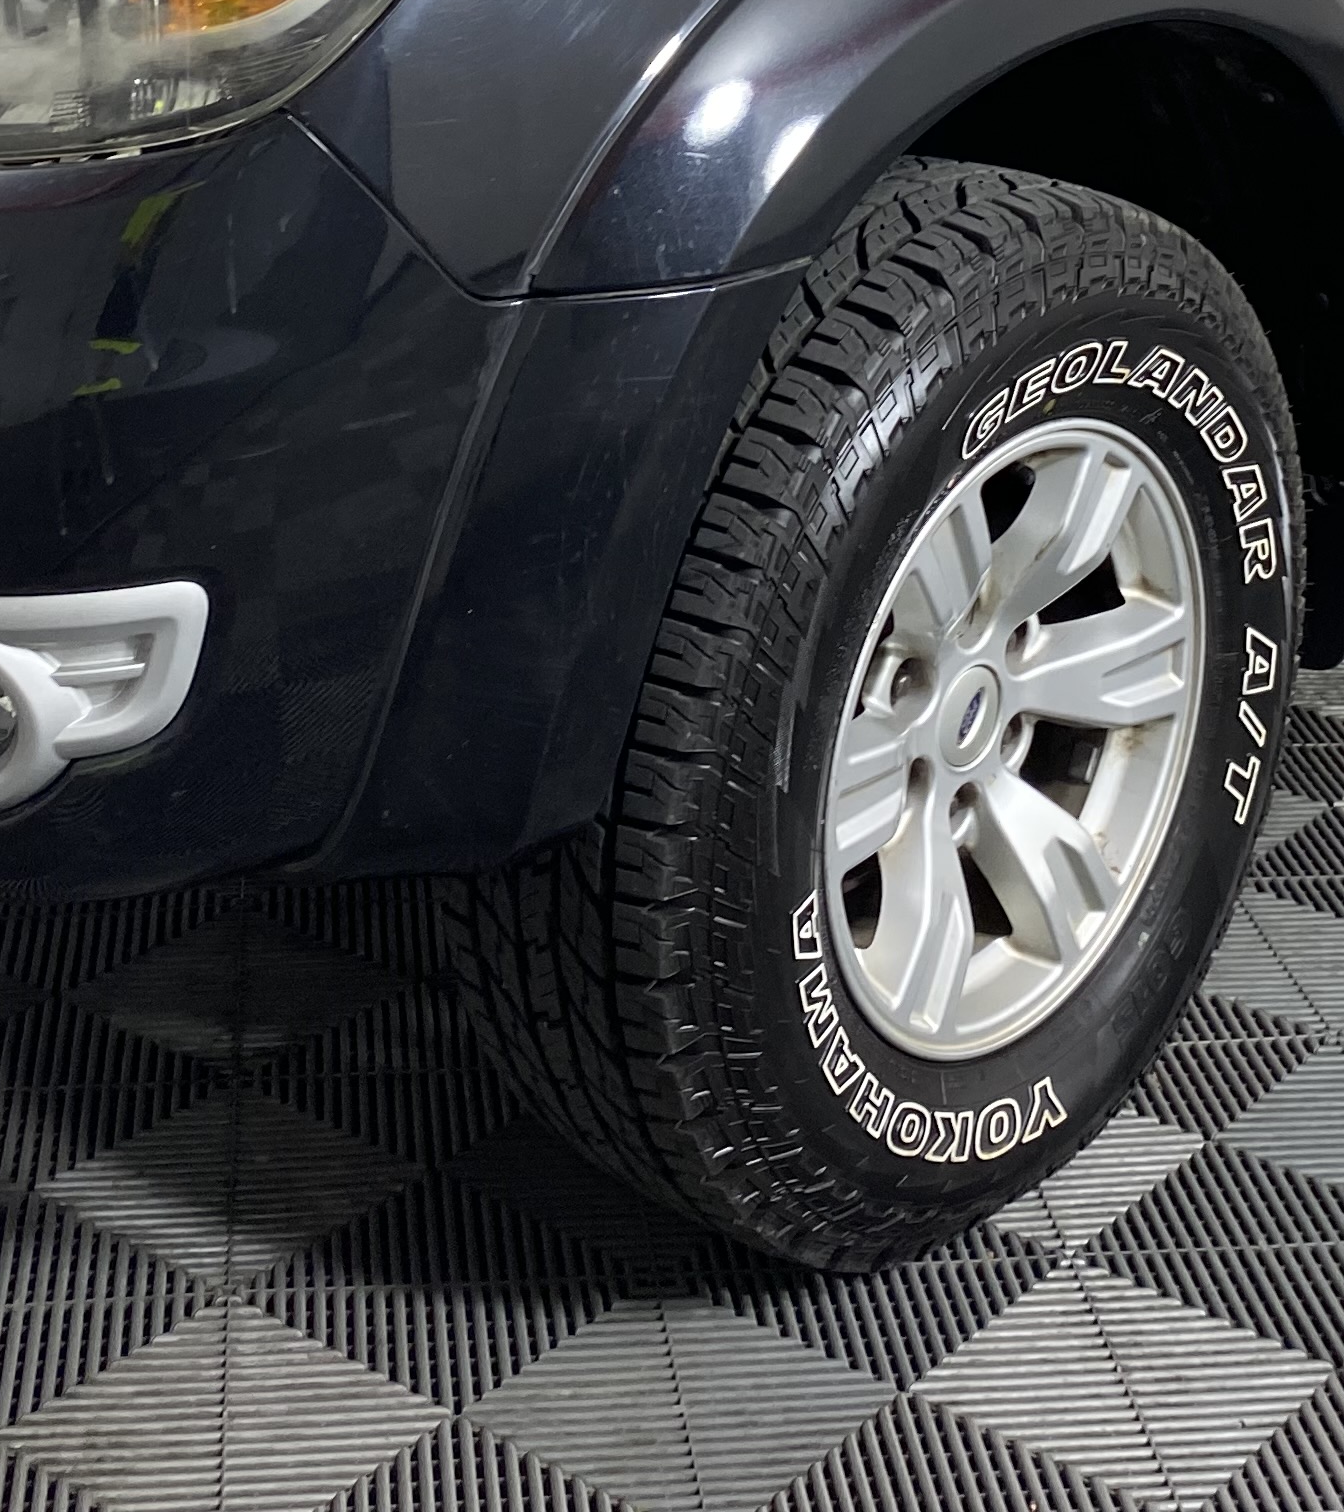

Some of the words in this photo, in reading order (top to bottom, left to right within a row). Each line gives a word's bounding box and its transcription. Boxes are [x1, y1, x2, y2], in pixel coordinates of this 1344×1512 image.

[962, 340, 1277, 584] GEOLANDAR
[1224, 626, 1277, 824] A/T
[793, 889, 1067, 1163] YOKOHAMA
